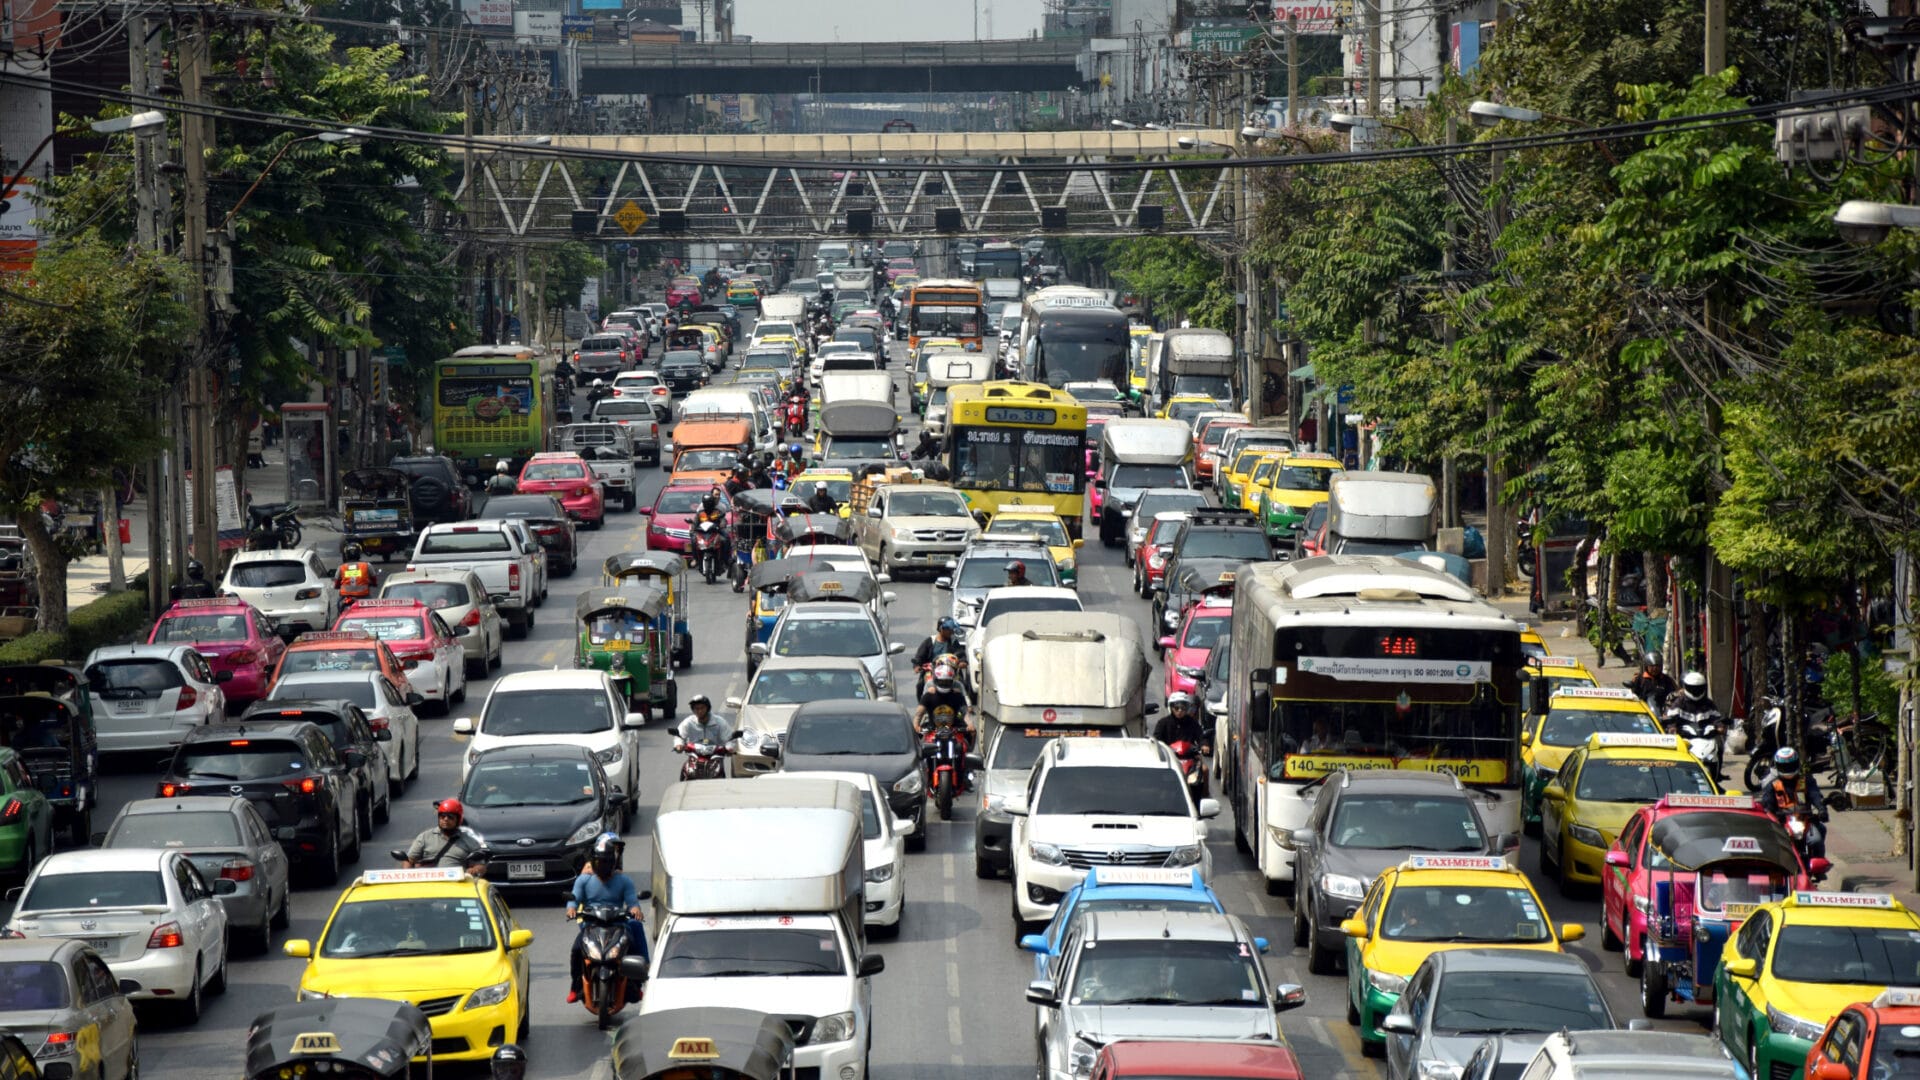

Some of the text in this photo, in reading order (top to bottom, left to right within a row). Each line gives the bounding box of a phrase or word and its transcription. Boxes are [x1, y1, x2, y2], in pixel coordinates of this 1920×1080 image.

[1381, 637, 1417, 654] 140
[1413, 668, 1424, 676] ISO
[1290, 760, 1314, 772] 140
[1679, 796, 1735, 806] TAXI-METER
[1730, 840, 1754, 849] TAXI
[1426, 858, 1490, 867] TAXI-METER
[381, 871, 445, 880] TAXI-METER
[1812, 896, 1877, 905] TAXI-METER
[302, 1037, 330, 1049] TAXI
[680, 1041, 709, 1054] TAXI
